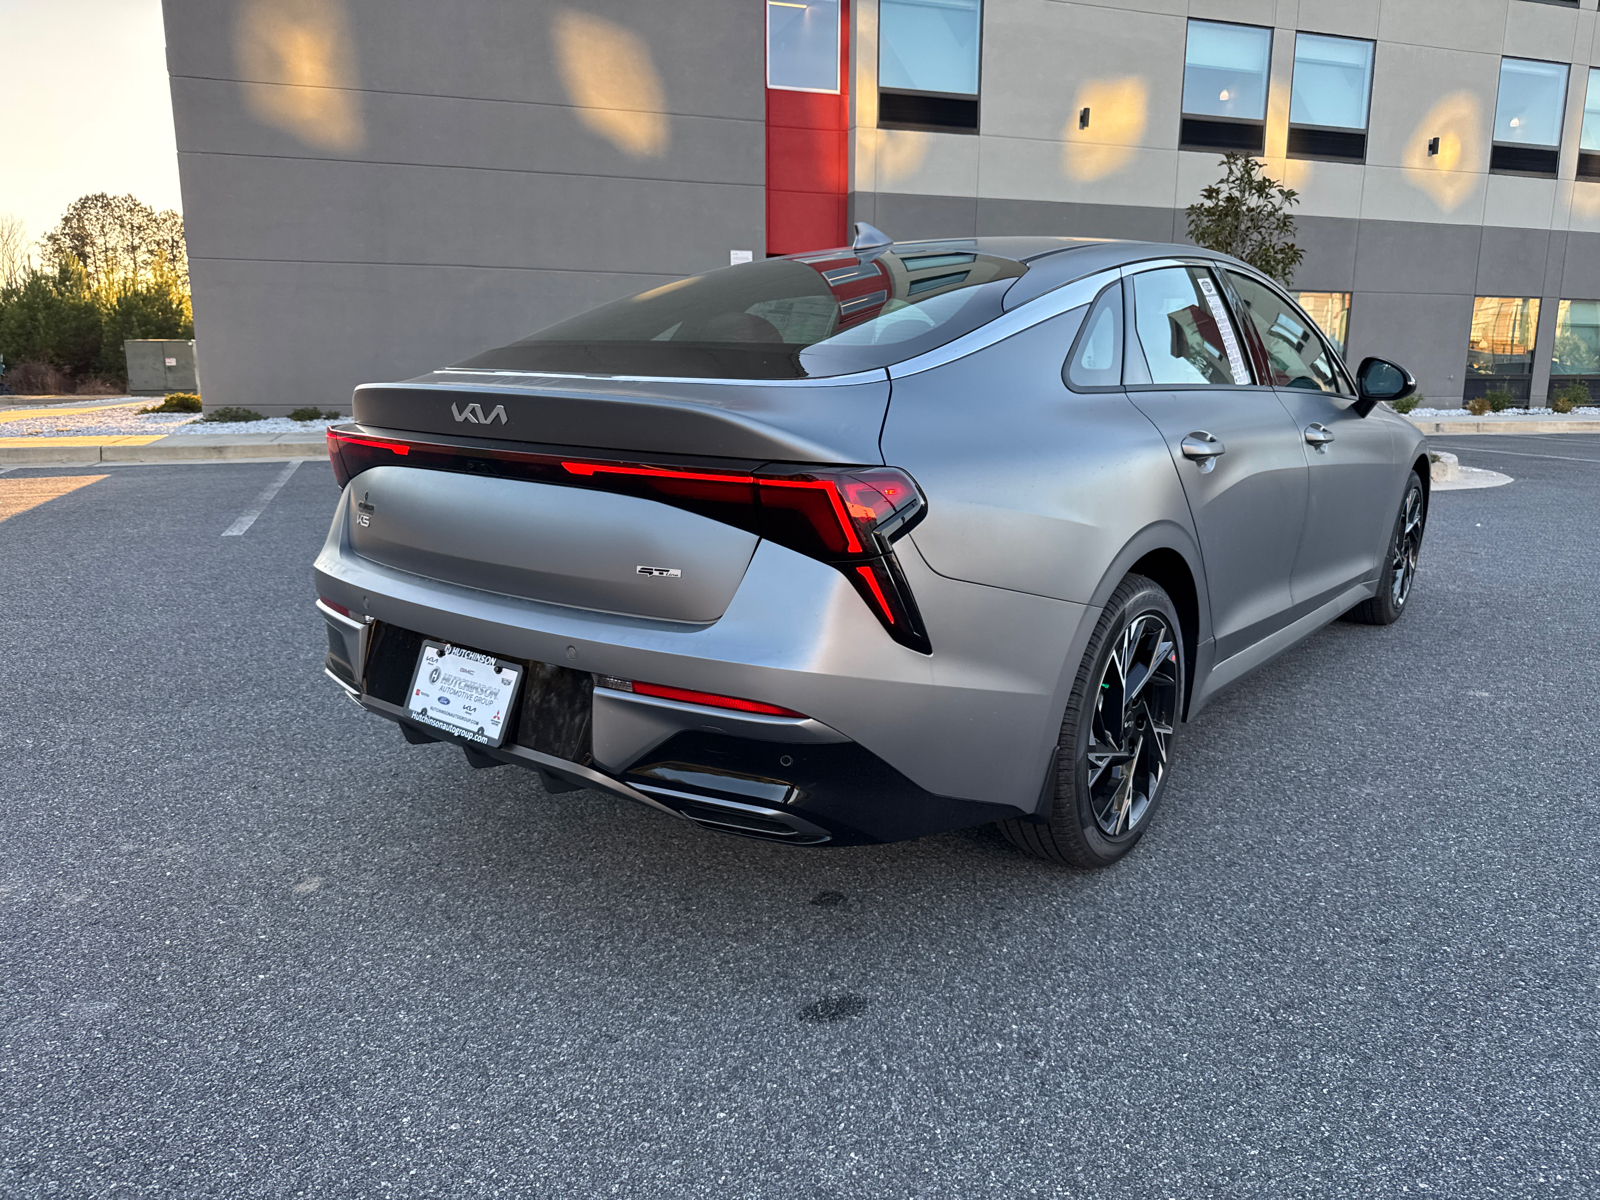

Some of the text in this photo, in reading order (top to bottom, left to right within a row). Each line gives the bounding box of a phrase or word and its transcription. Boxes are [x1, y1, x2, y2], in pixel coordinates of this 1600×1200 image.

[451, 402, 509, 425] KIA
[357, 514, 371, 528] K5
[452, 647, 497, 667] HUTCHINSON
[460, 667, 475, 676] GMC
[439, 685, 494, 706] AUTOMOTIVE GROUP
[462, 704, 477, 713] KIA
[411, 711, 488, 745] Hutchinsonautogroup.com
